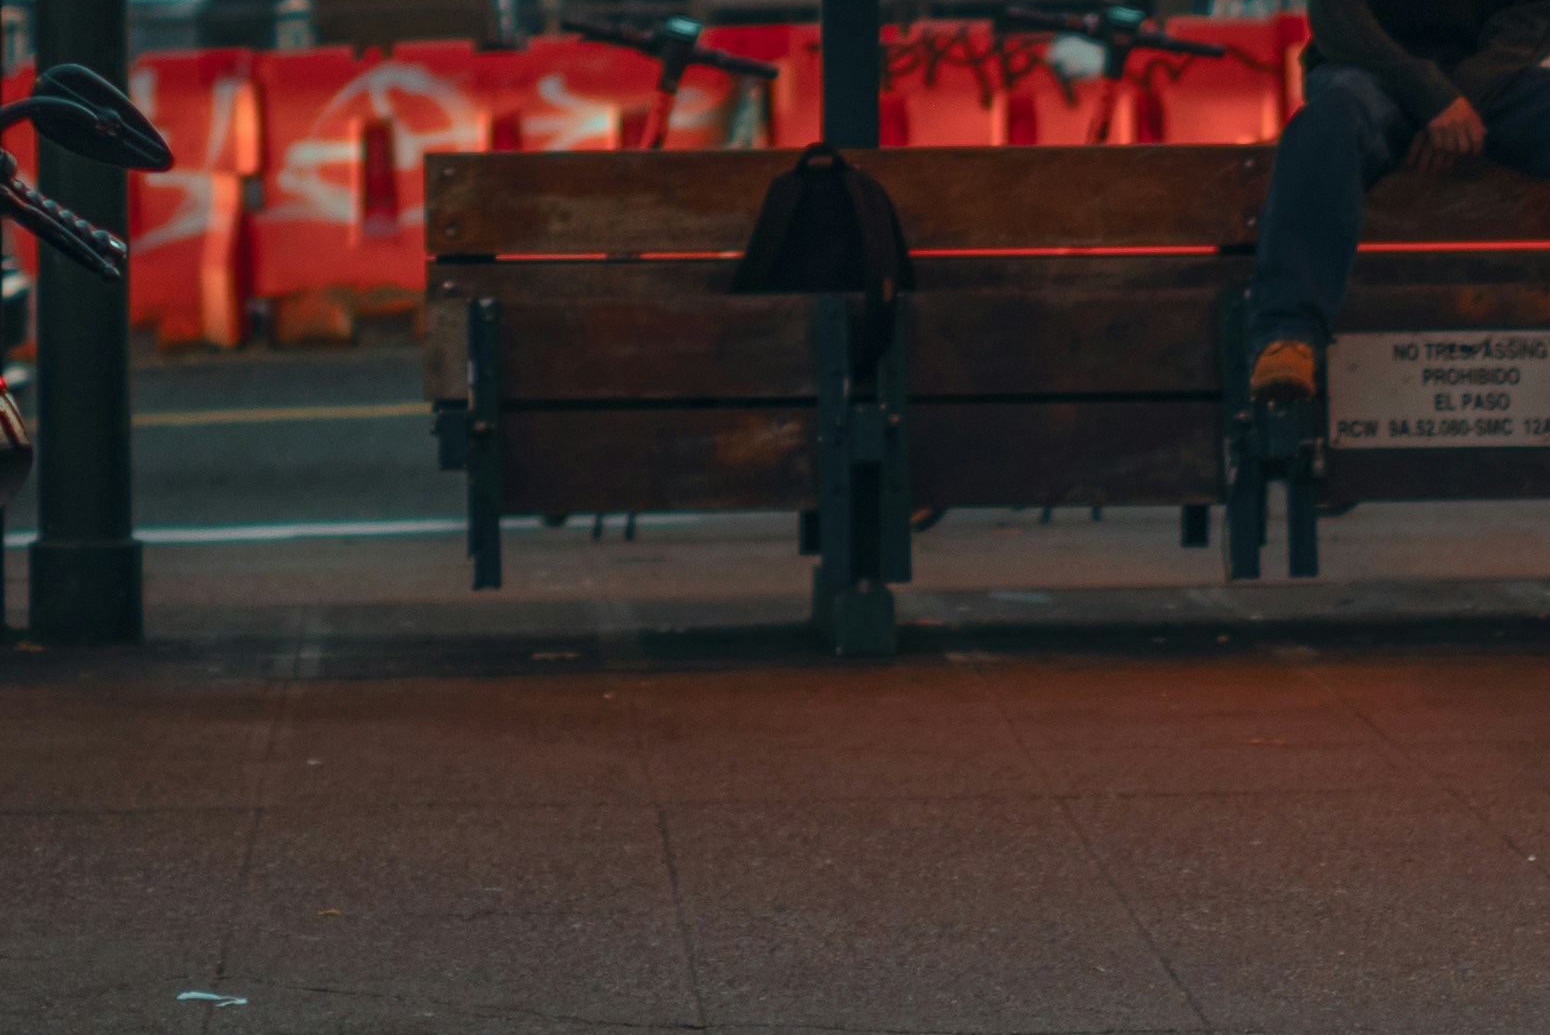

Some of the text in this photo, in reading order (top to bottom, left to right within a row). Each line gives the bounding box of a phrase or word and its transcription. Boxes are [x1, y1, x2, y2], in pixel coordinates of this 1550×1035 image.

[1392, 343, 1419, 362] NO
[1422, 367, 1521, 386] PROHIBIDO
[1434, 392, 1511, 411] EL PASO
